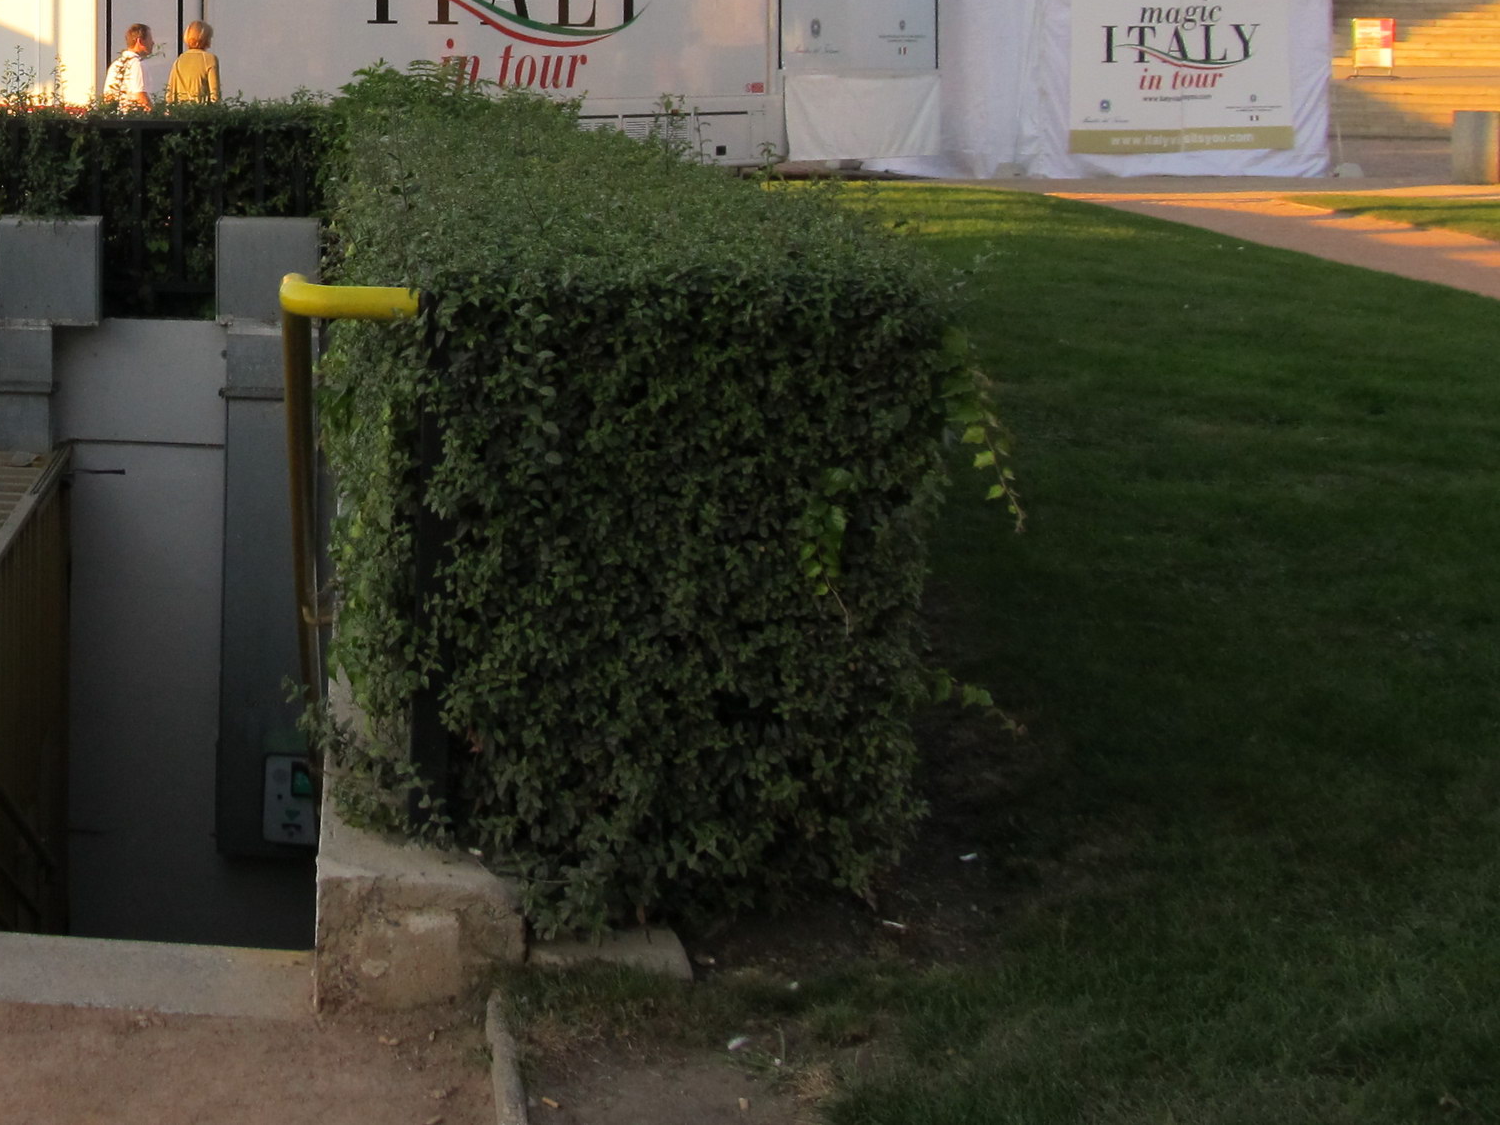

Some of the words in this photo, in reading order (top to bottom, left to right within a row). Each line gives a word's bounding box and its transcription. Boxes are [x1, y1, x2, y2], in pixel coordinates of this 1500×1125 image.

[1101, 24, 1260, 63] ITALY
[499, 44, 588, 89] tour
[1139, 68, 1162, 90] in
[1172, 71, 1223, 90] tour
